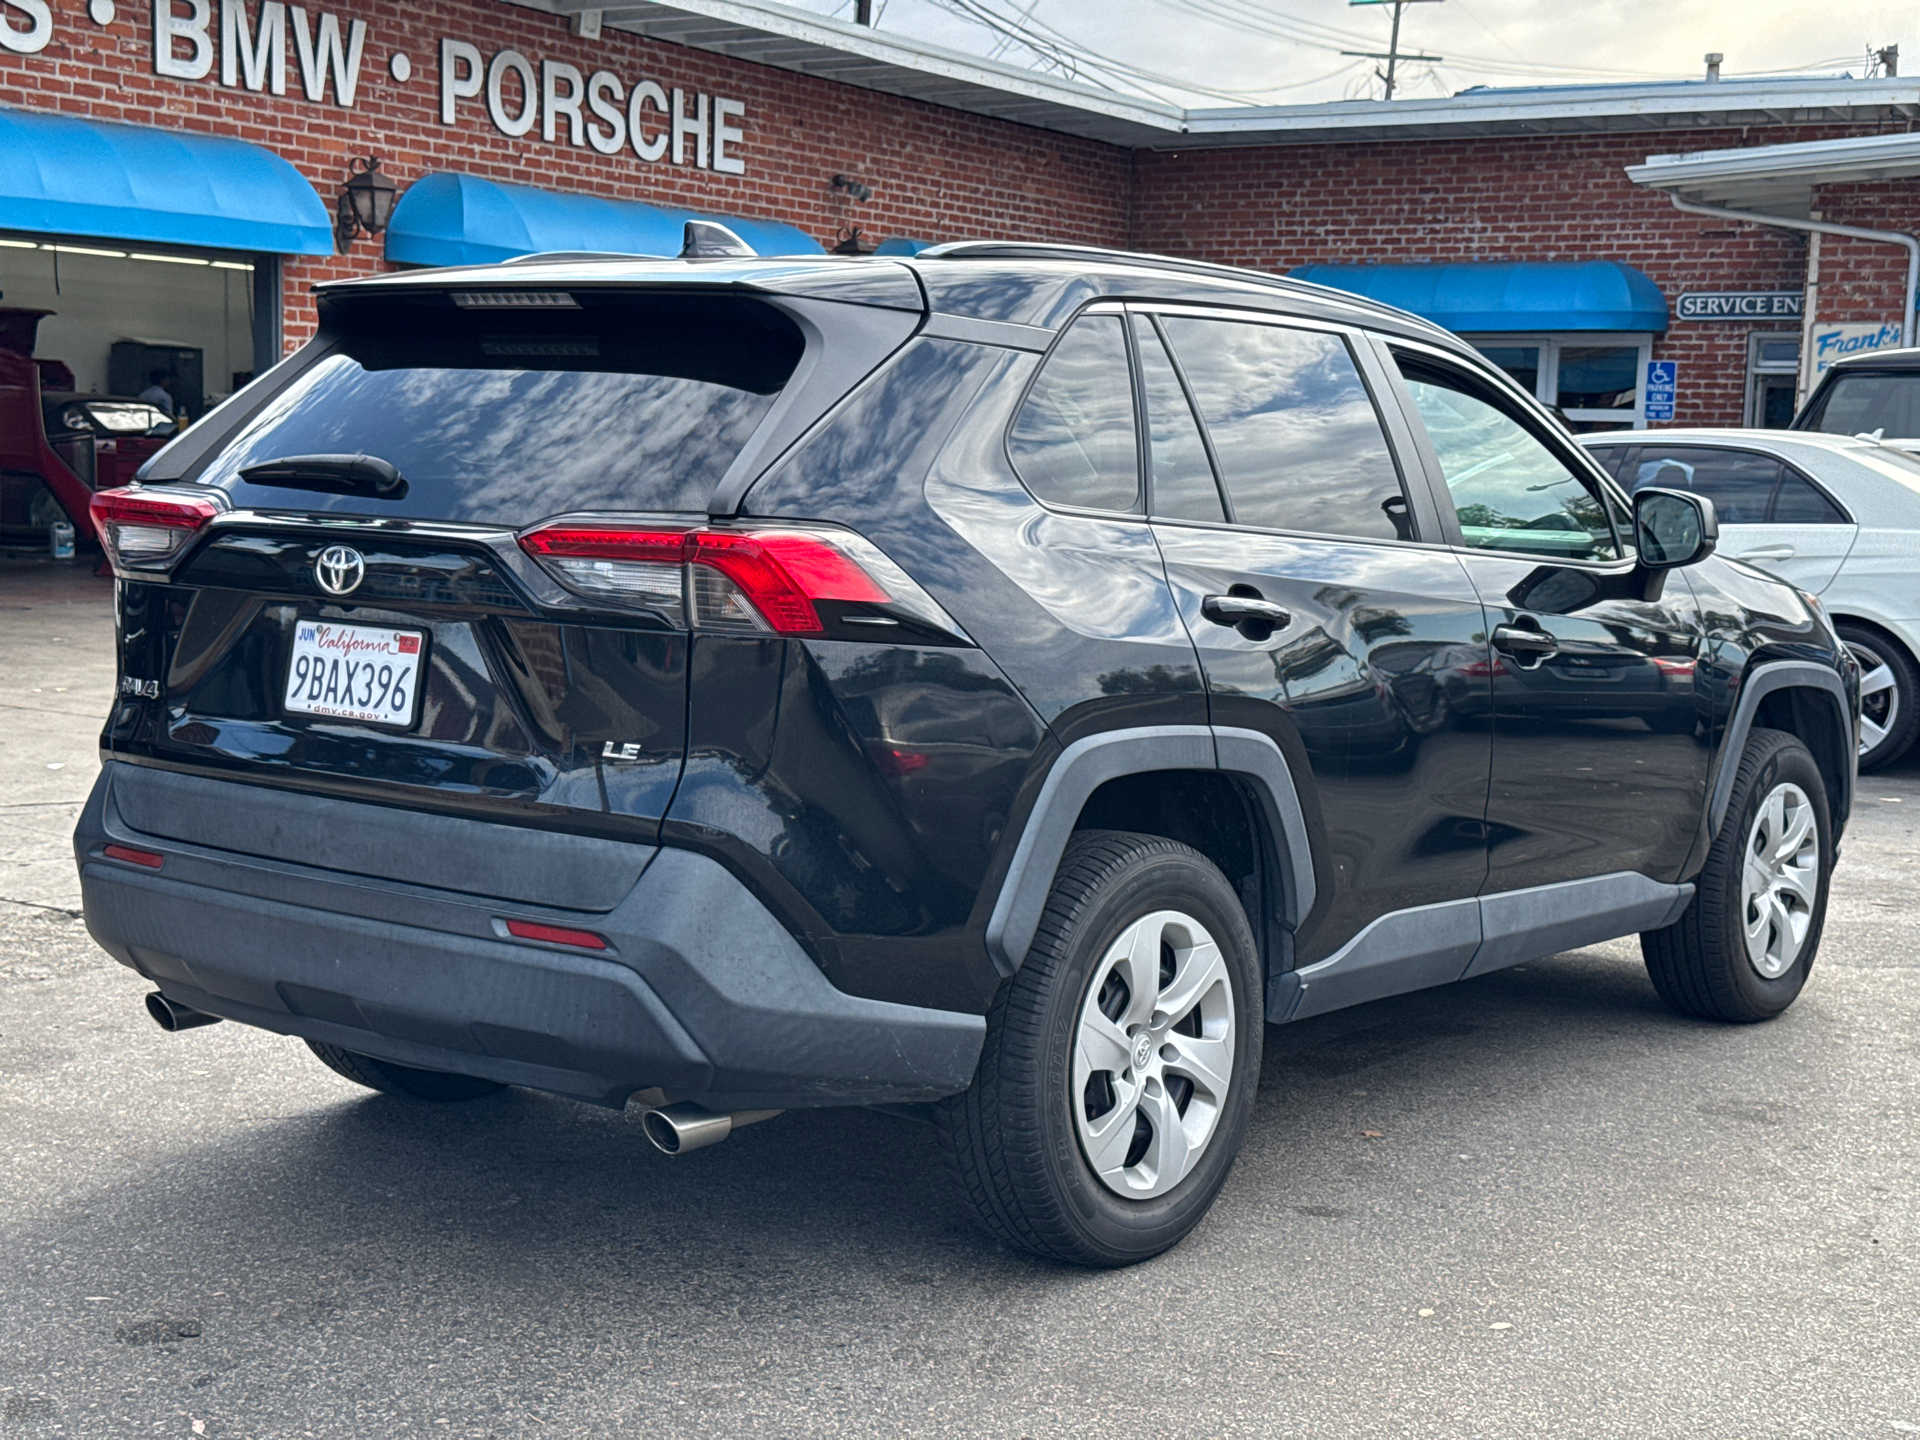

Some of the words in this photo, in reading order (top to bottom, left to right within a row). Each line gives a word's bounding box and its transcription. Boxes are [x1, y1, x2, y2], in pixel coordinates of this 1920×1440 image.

[153, 0, 368, 108] BMW
[440, 38, 746, 175] PORSCHE
[1683, 297, 1767, 315] SERVICE
[1771, 297, 1803, 314] EN
[1816, 325, 1901, 357] Frank's
[1647, 383, 1674, 393] PARKING
[1651, 393, 1668, 402] ONLY
[298, 627, 316, 642] JUN
[318, 626, 399, 657] California
[291, 655, 412, 712] 9BAX396
[313, 704, 380, 721] dmv.ca.gov
[602, 741, 641, 760] LE
